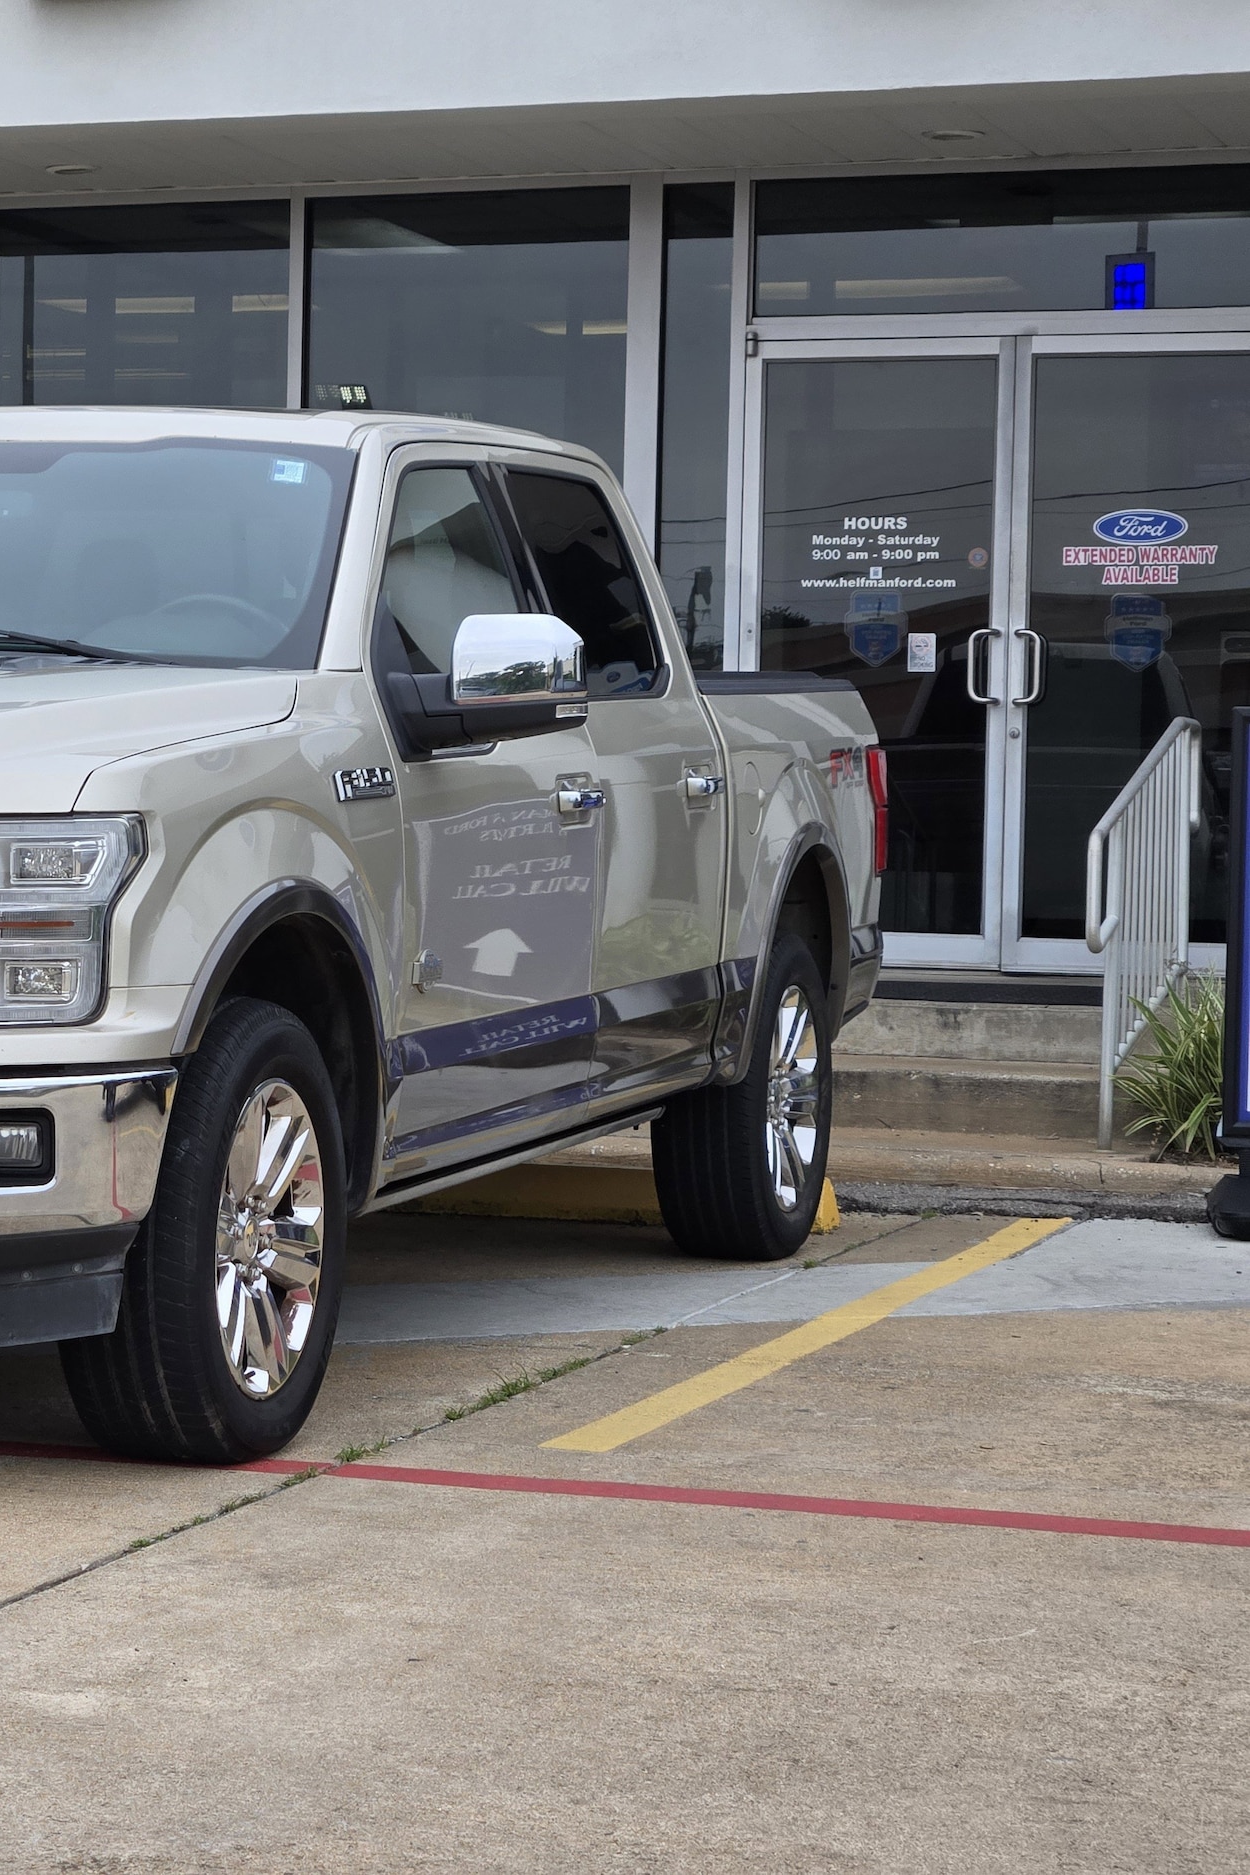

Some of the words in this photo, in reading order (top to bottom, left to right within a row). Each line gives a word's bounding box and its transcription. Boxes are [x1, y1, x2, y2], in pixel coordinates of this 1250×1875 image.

[844, 517, 908, 530] HOURS
[1113, 515, 1168, 537] Ford
[811, 534, 865, 547] Monday
[877, 534, 940, 547] Saturday
[811, 549, 841, 560] 9:00
[846, 551, 869, 560] am
[881, 549, 913, 560] 9:00
[916, 551, 940, 562] pm
[1063, 547, 1136, 565] EXTENDED
[1138, 545, 1218, 565] WARRANTY
[801, 577, 957, 588] www.helfmanford.com
[1102, 565, 1178, 585] AVAILABLE
[830, 746, 863, 789] FX4
